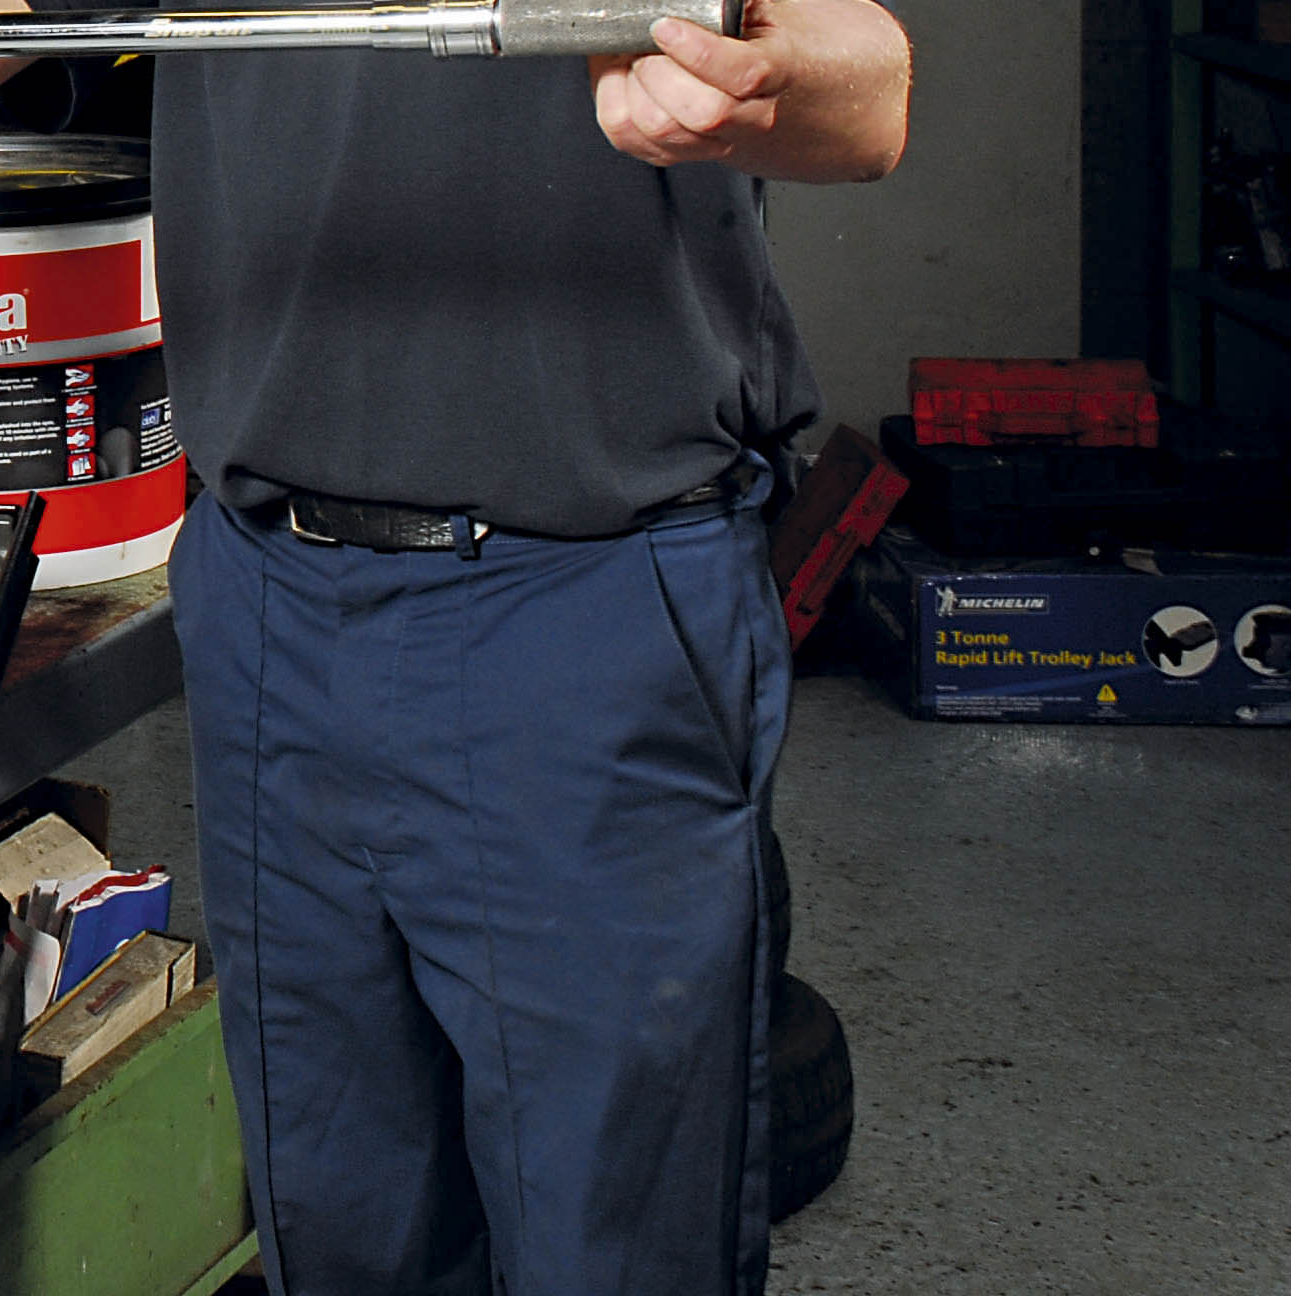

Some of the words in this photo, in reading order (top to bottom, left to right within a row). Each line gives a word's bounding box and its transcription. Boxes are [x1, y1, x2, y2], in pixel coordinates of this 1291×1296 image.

[958, 598, 1046, 609] MICHELIN
[935, 630, 947, 645] 3
[951, 630, 1010, 645] Tonne
[935, 650, 988, 667] Rapid
[993, 650, 1025, 665] Lift
[1029, 650, 1092, 668] Trolley
[1097, 650, 1137, 665] Jack
